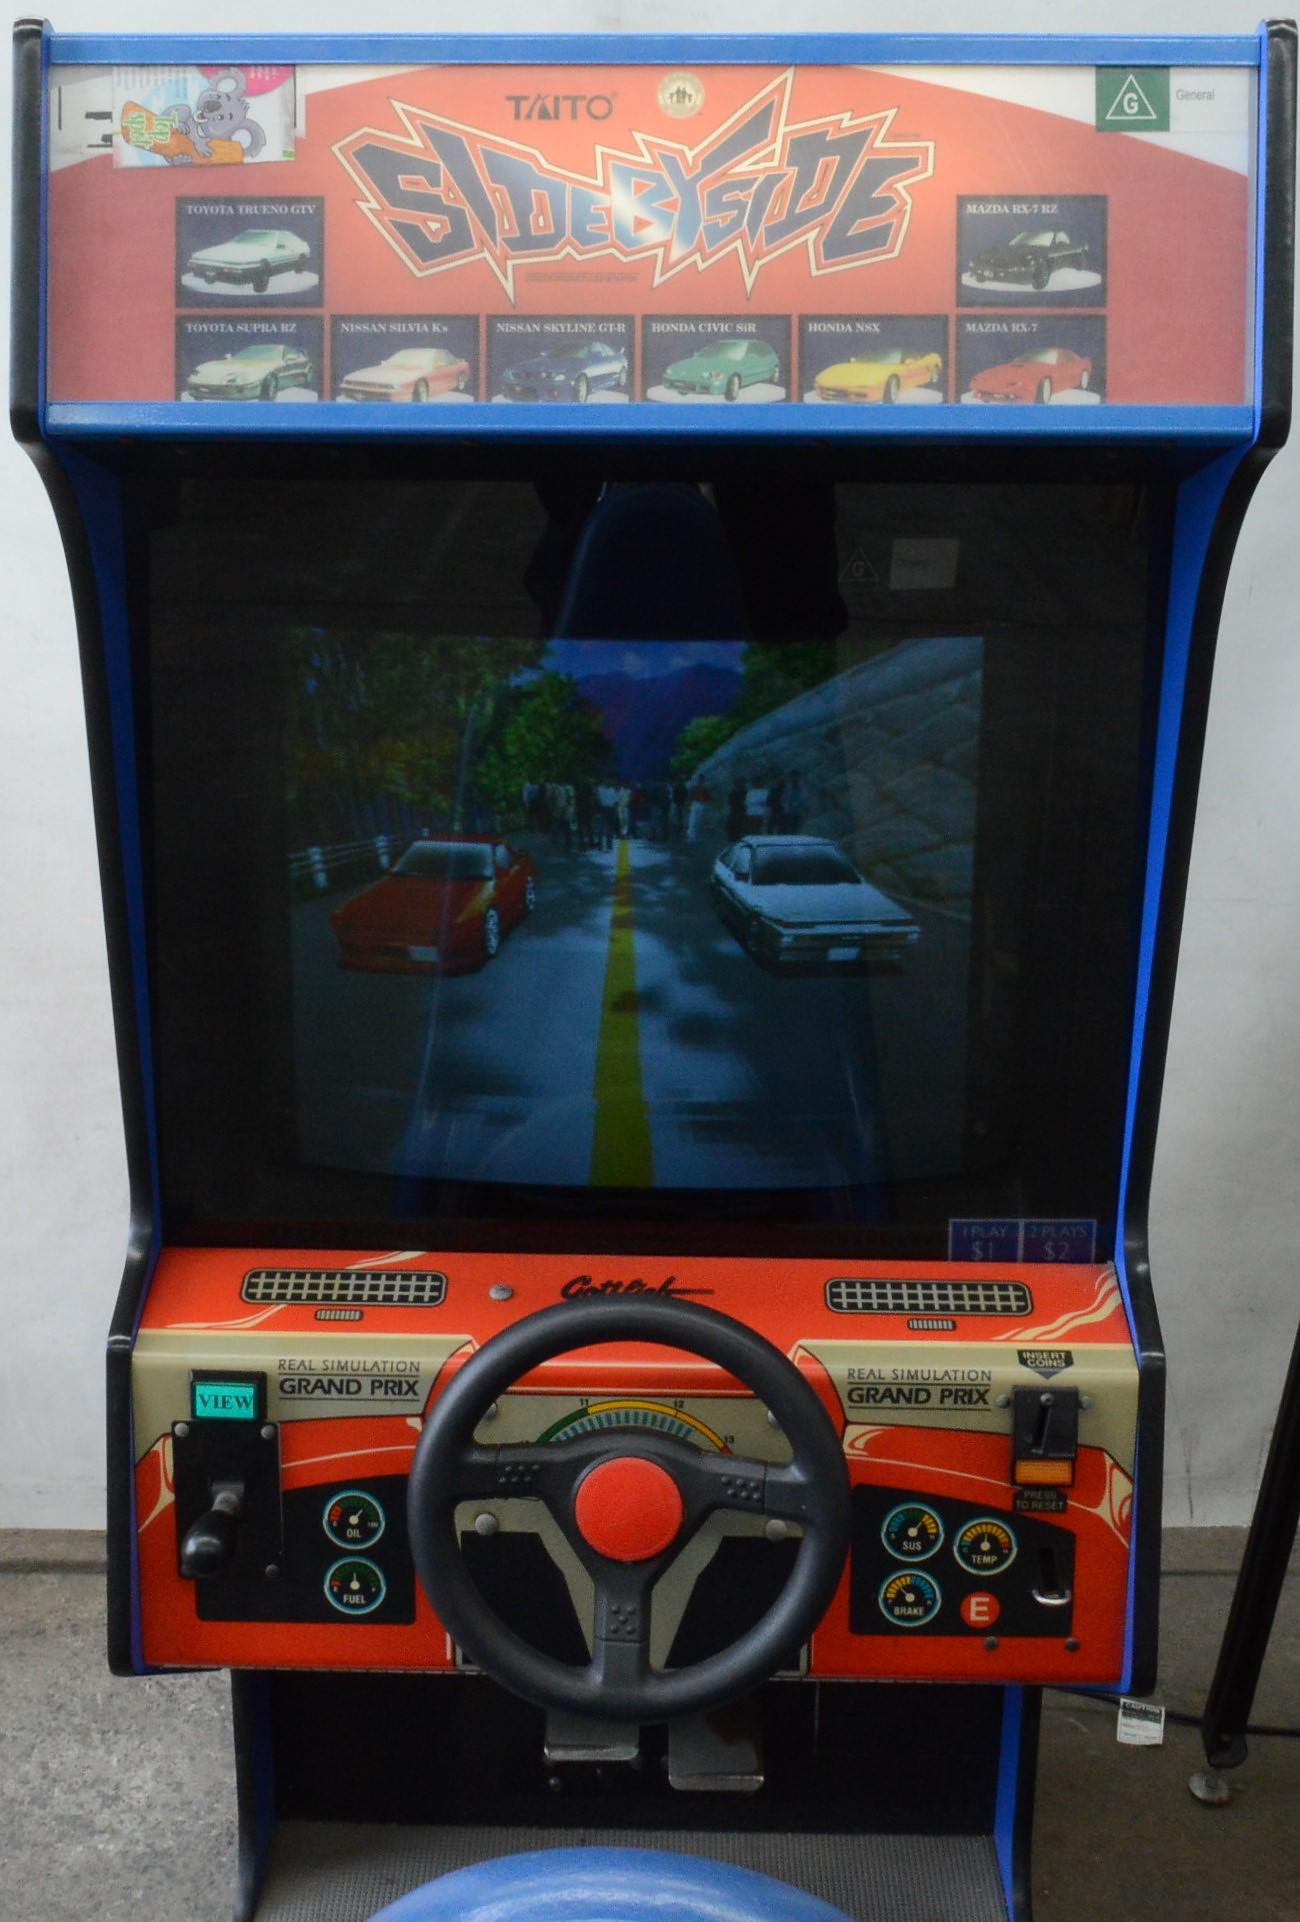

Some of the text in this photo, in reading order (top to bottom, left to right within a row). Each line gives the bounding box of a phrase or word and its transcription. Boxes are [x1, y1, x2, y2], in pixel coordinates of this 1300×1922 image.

[1176, 88, 1215, 101] General
[505, 94, 613, 121] TAITO
[1123, 92, 1139, 114] G
[186, 205, 317, 216] TOYOTA TRUENO GTV
[966, 203, 1059, 214] MAZDA RX-7 RZ
[186, 323, 297, 333] TOYOTA SUPRA RZ
[341, 323, 385, 333] NISSAN
[389, 323, 429, 333] SILVIA
[496, 323, 626, 334] NISSAN SKYLINE GT-R
[652, 323, 695, 333] HONDA
[699, 323, 731, 333] CIVIC
[808, 323, 880, 333] HONDA NSX
[965, 323, 1038, 333] MAZDA RX-7
[972, 1225, 1007, 1238] PLAY
[1041, 1225, 1088, 1238] PLAYS
[1023, 1352, 1065, 1360] INSERT
[278, 1359, 420, 1372] REAL SIMULATION
[1027, 1359, 1066, 1367] COINS
[848, 1368, 992, 1382] REAL SIMULATION
[279, 1378, 419, 1396] GRAND PRIX
[847, 1387, 990, 1405] GRAND PRIX
[199, 1395, 253, 1409] VIEW
[346, 1528, 360, 1537] OIL
[903, 1541, 922, 1550] SUS
[972, 1555, 998, 1564] TEMP
[343, 1594, 366, 1604] FUEL
[894, 1606, 924, 1616] BRAKE
[970, 1597, 990, 1621] E
